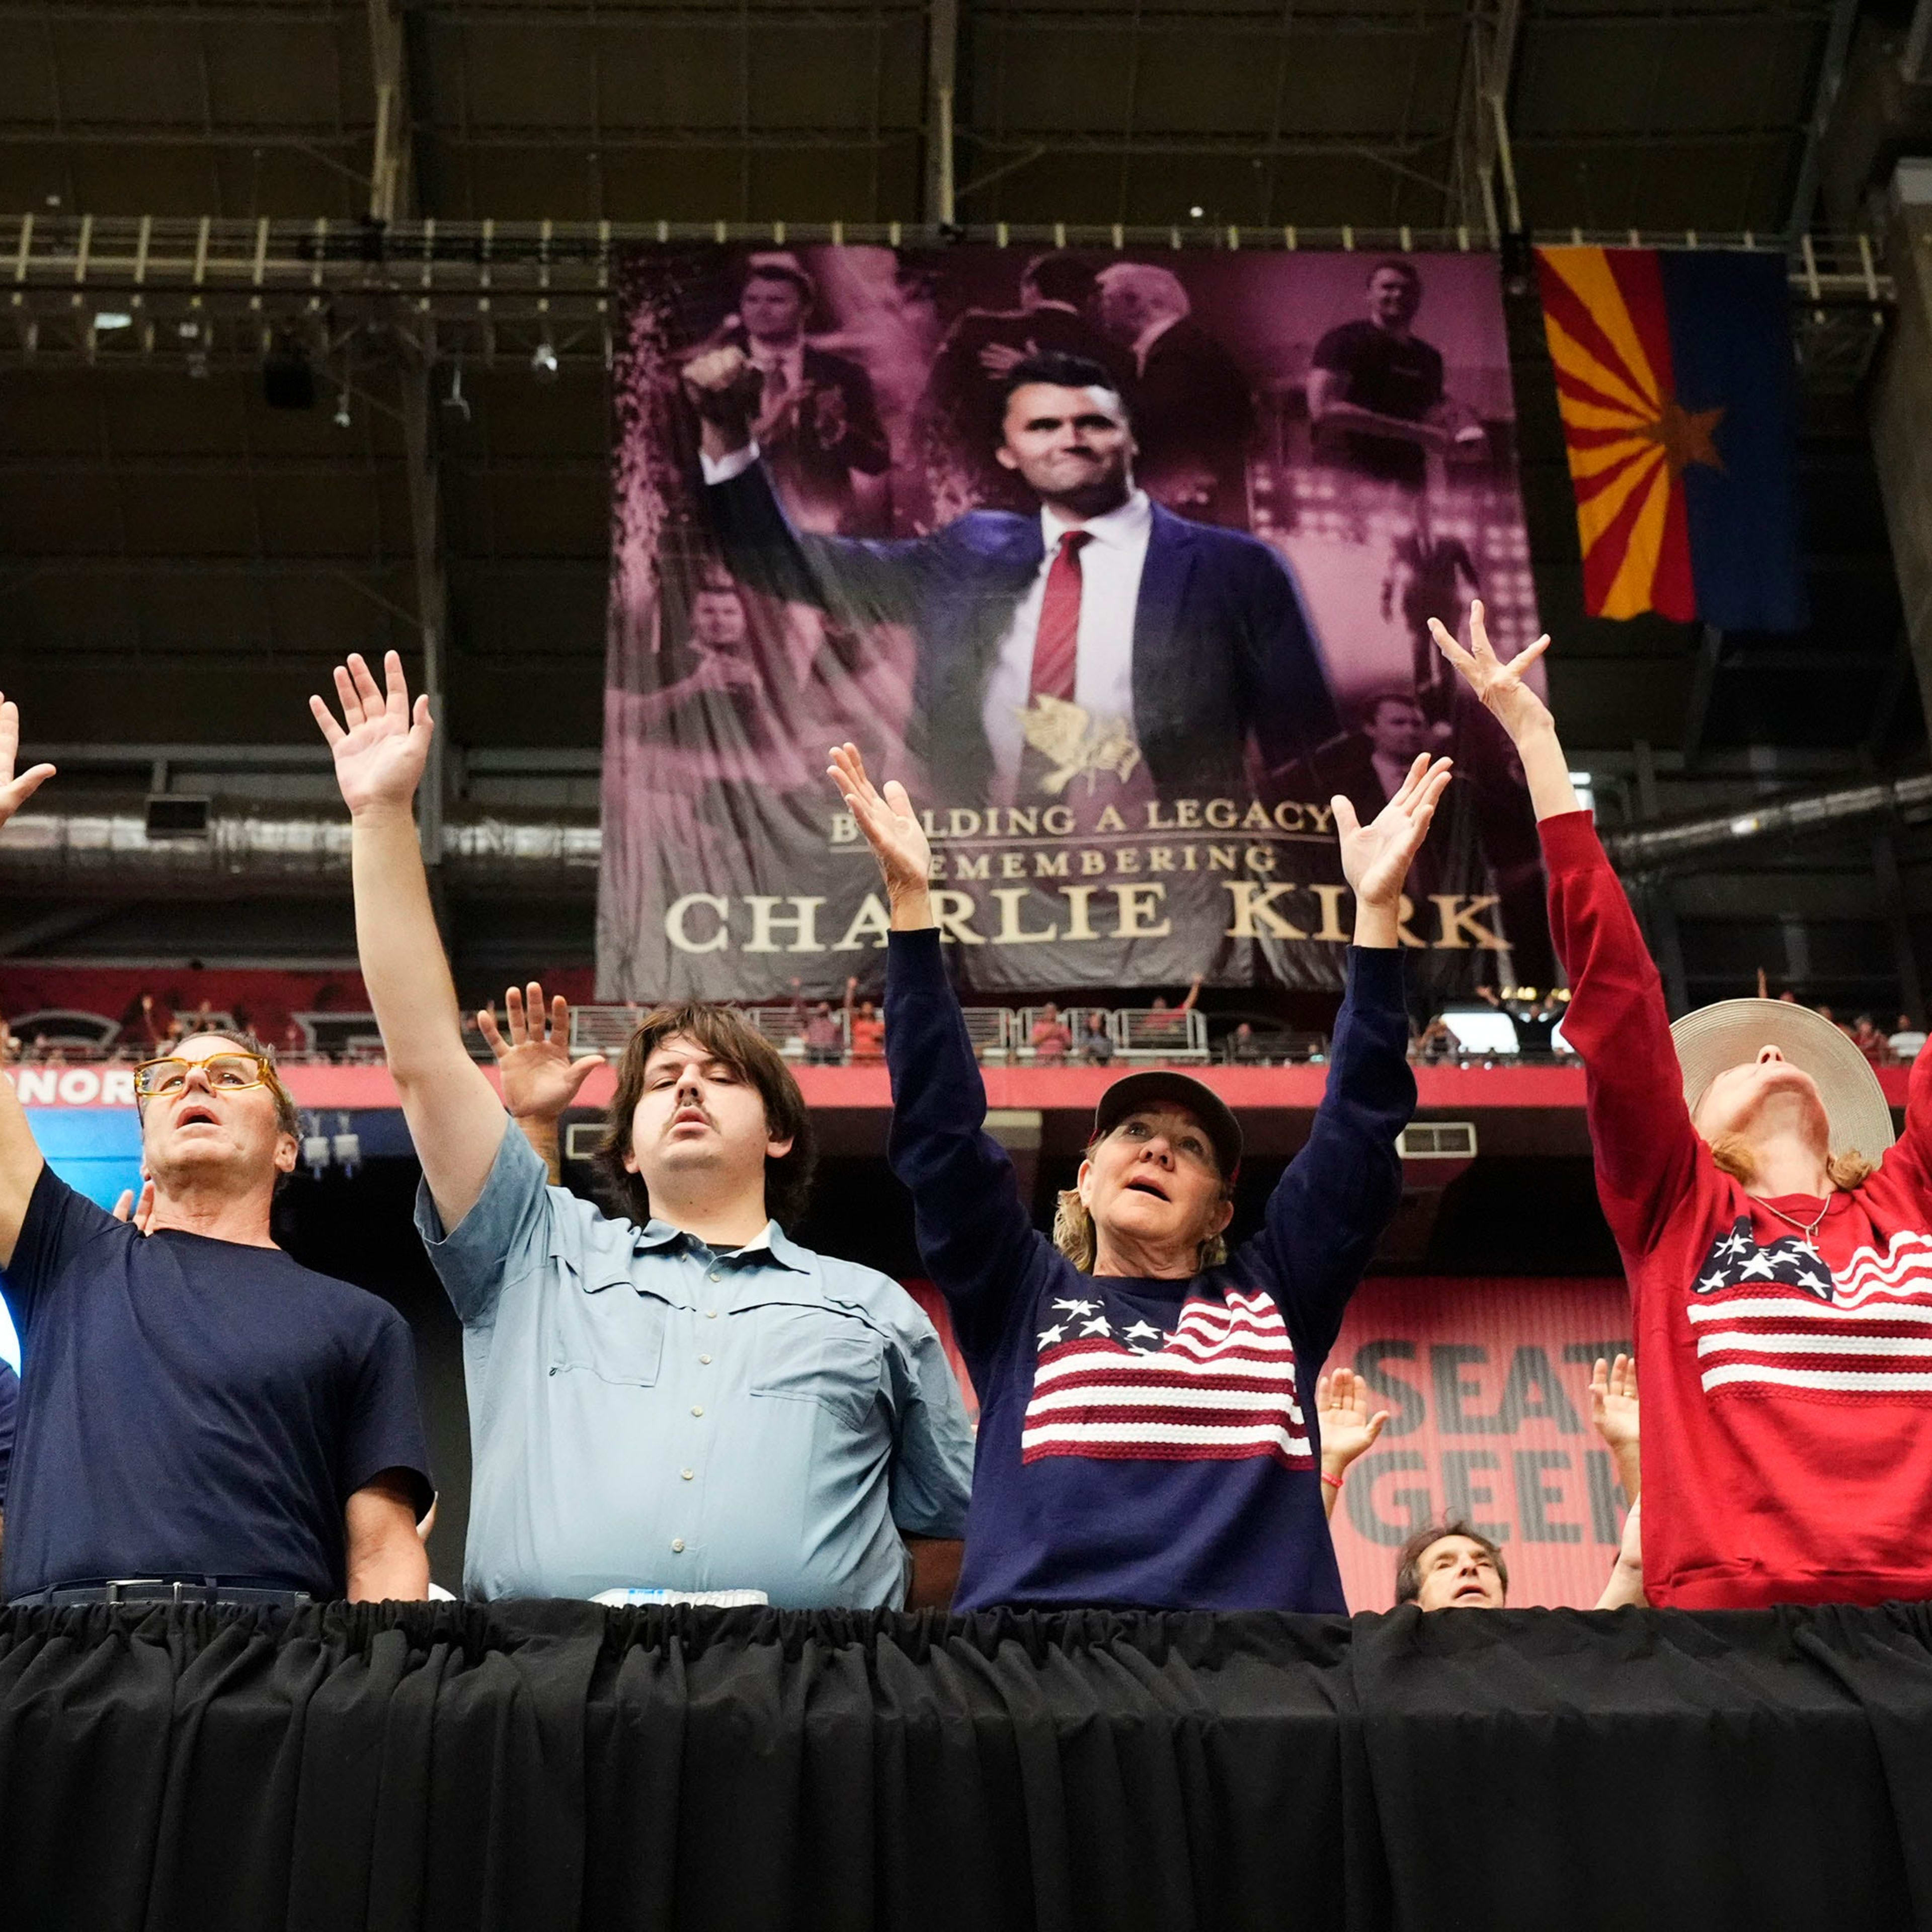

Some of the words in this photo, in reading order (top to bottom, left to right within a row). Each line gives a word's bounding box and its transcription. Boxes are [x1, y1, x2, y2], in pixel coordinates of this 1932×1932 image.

[831, 805, 1076, 843] BLDING
[1095, 805, 1127, 833] A
[1146, 798, 1333, 833] LEGACY
[928, 845, 1277, 880] EMEMBERING
[665, 881, 1172, 953] CHARLIE
[4, 1069, 136, 1105] NOR
